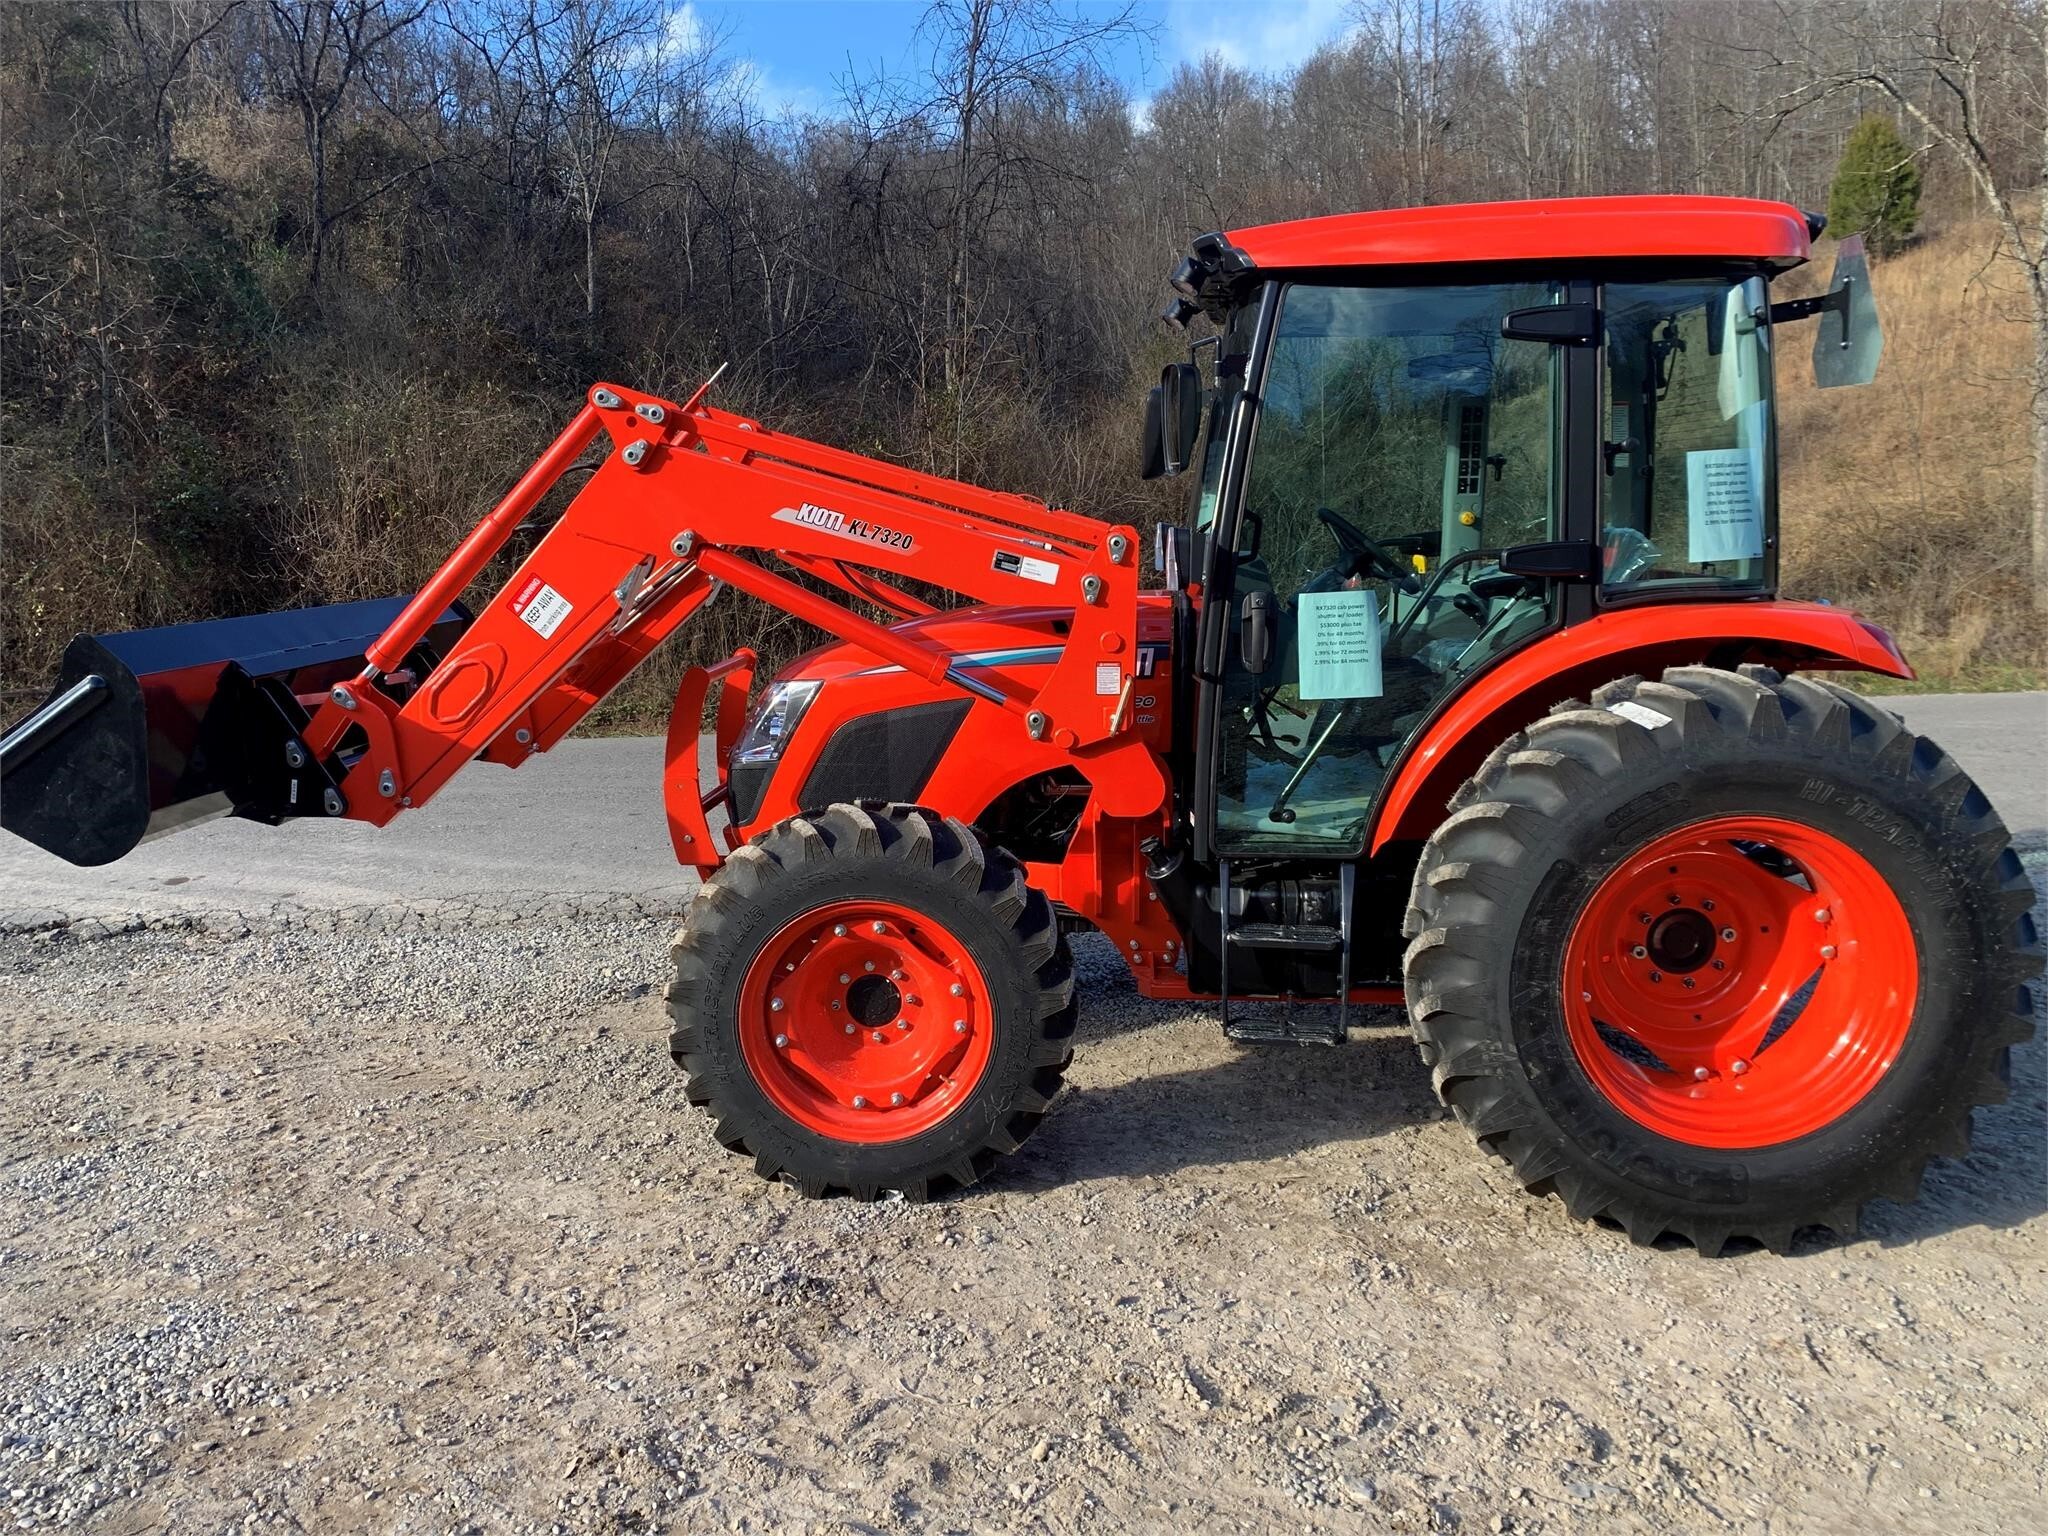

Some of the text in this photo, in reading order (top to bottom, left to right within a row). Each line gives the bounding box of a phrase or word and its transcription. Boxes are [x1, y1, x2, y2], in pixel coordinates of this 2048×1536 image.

[796, 502, 914, 550] KIOTI KL7320
[518, 577, 541, 604] WARNING
[525, 588, 556, 625] KEEP AWAY
[729, 905, 765, 945] LUG
